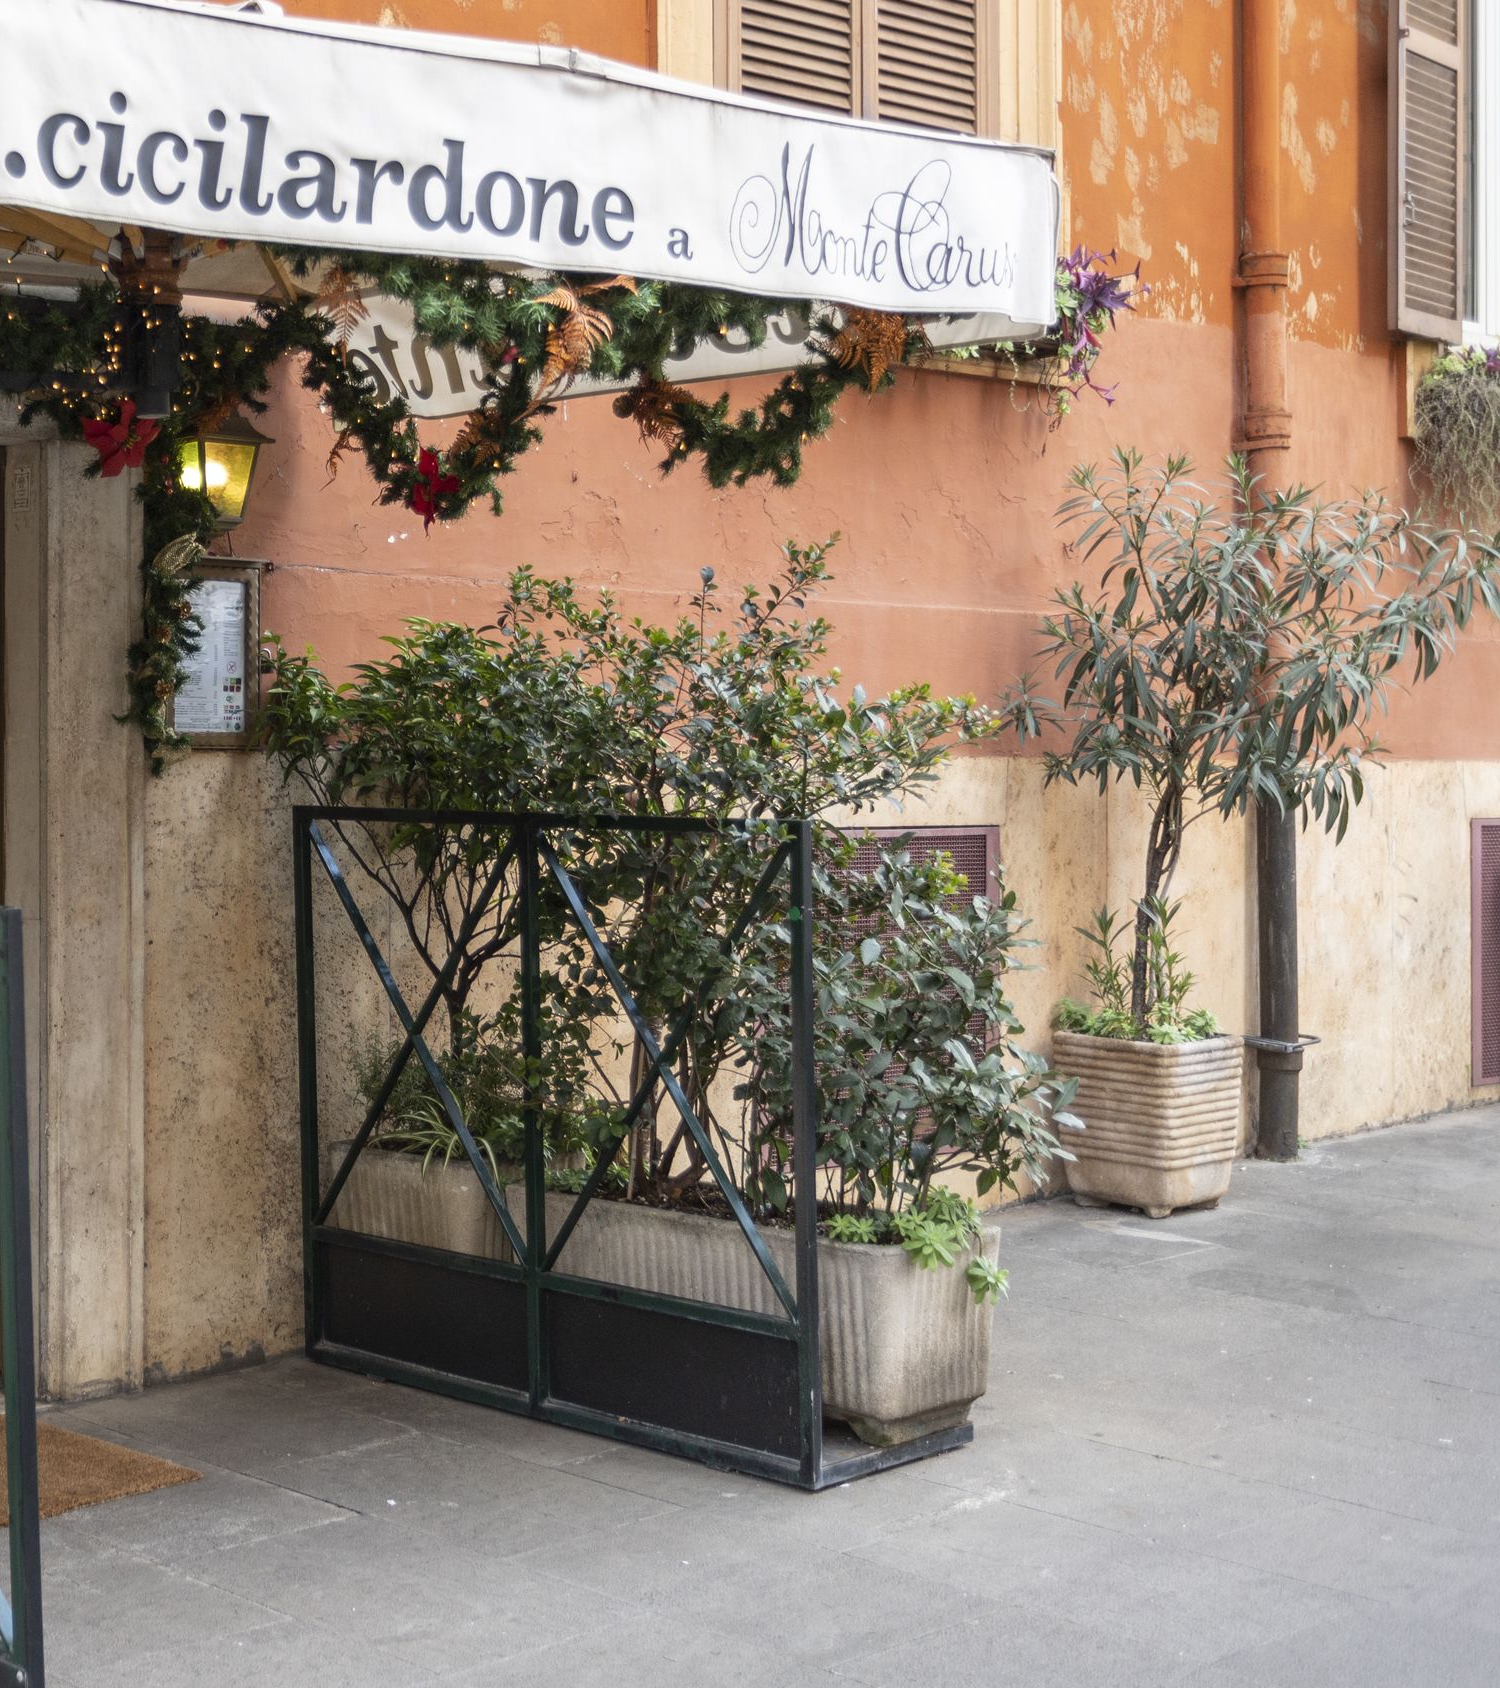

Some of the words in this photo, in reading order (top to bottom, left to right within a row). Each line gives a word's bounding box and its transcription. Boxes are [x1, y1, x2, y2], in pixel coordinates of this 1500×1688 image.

[666, 228, 695, 261] a
[729, 140, 889, 284] Monte
[872, 158, 1018, 292] Carus
